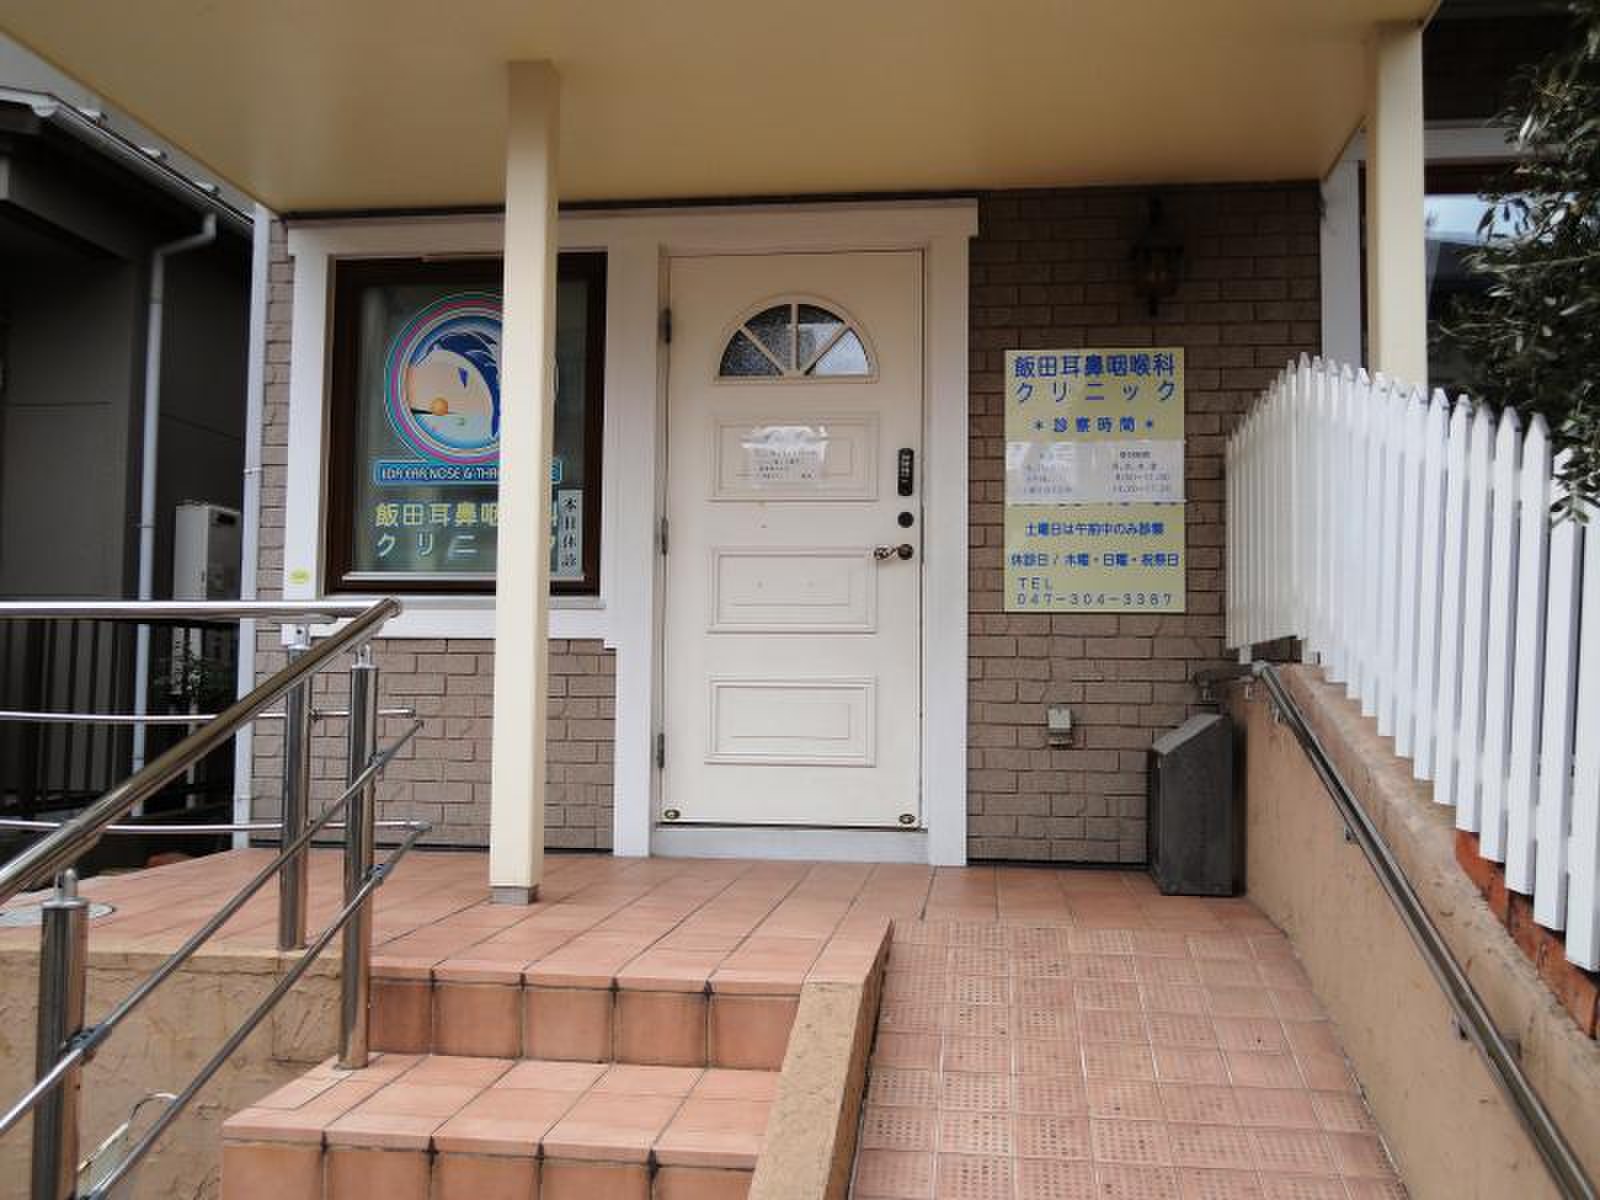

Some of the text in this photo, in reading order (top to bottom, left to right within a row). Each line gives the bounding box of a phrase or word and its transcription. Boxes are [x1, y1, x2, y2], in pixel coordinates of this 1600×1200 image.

[1014, 352, 1175, 378] 飯田耳鼻咽喉科
[1016, 381, 1175, 403] クリニック
[1017, 576, 1053, 590] TEL
